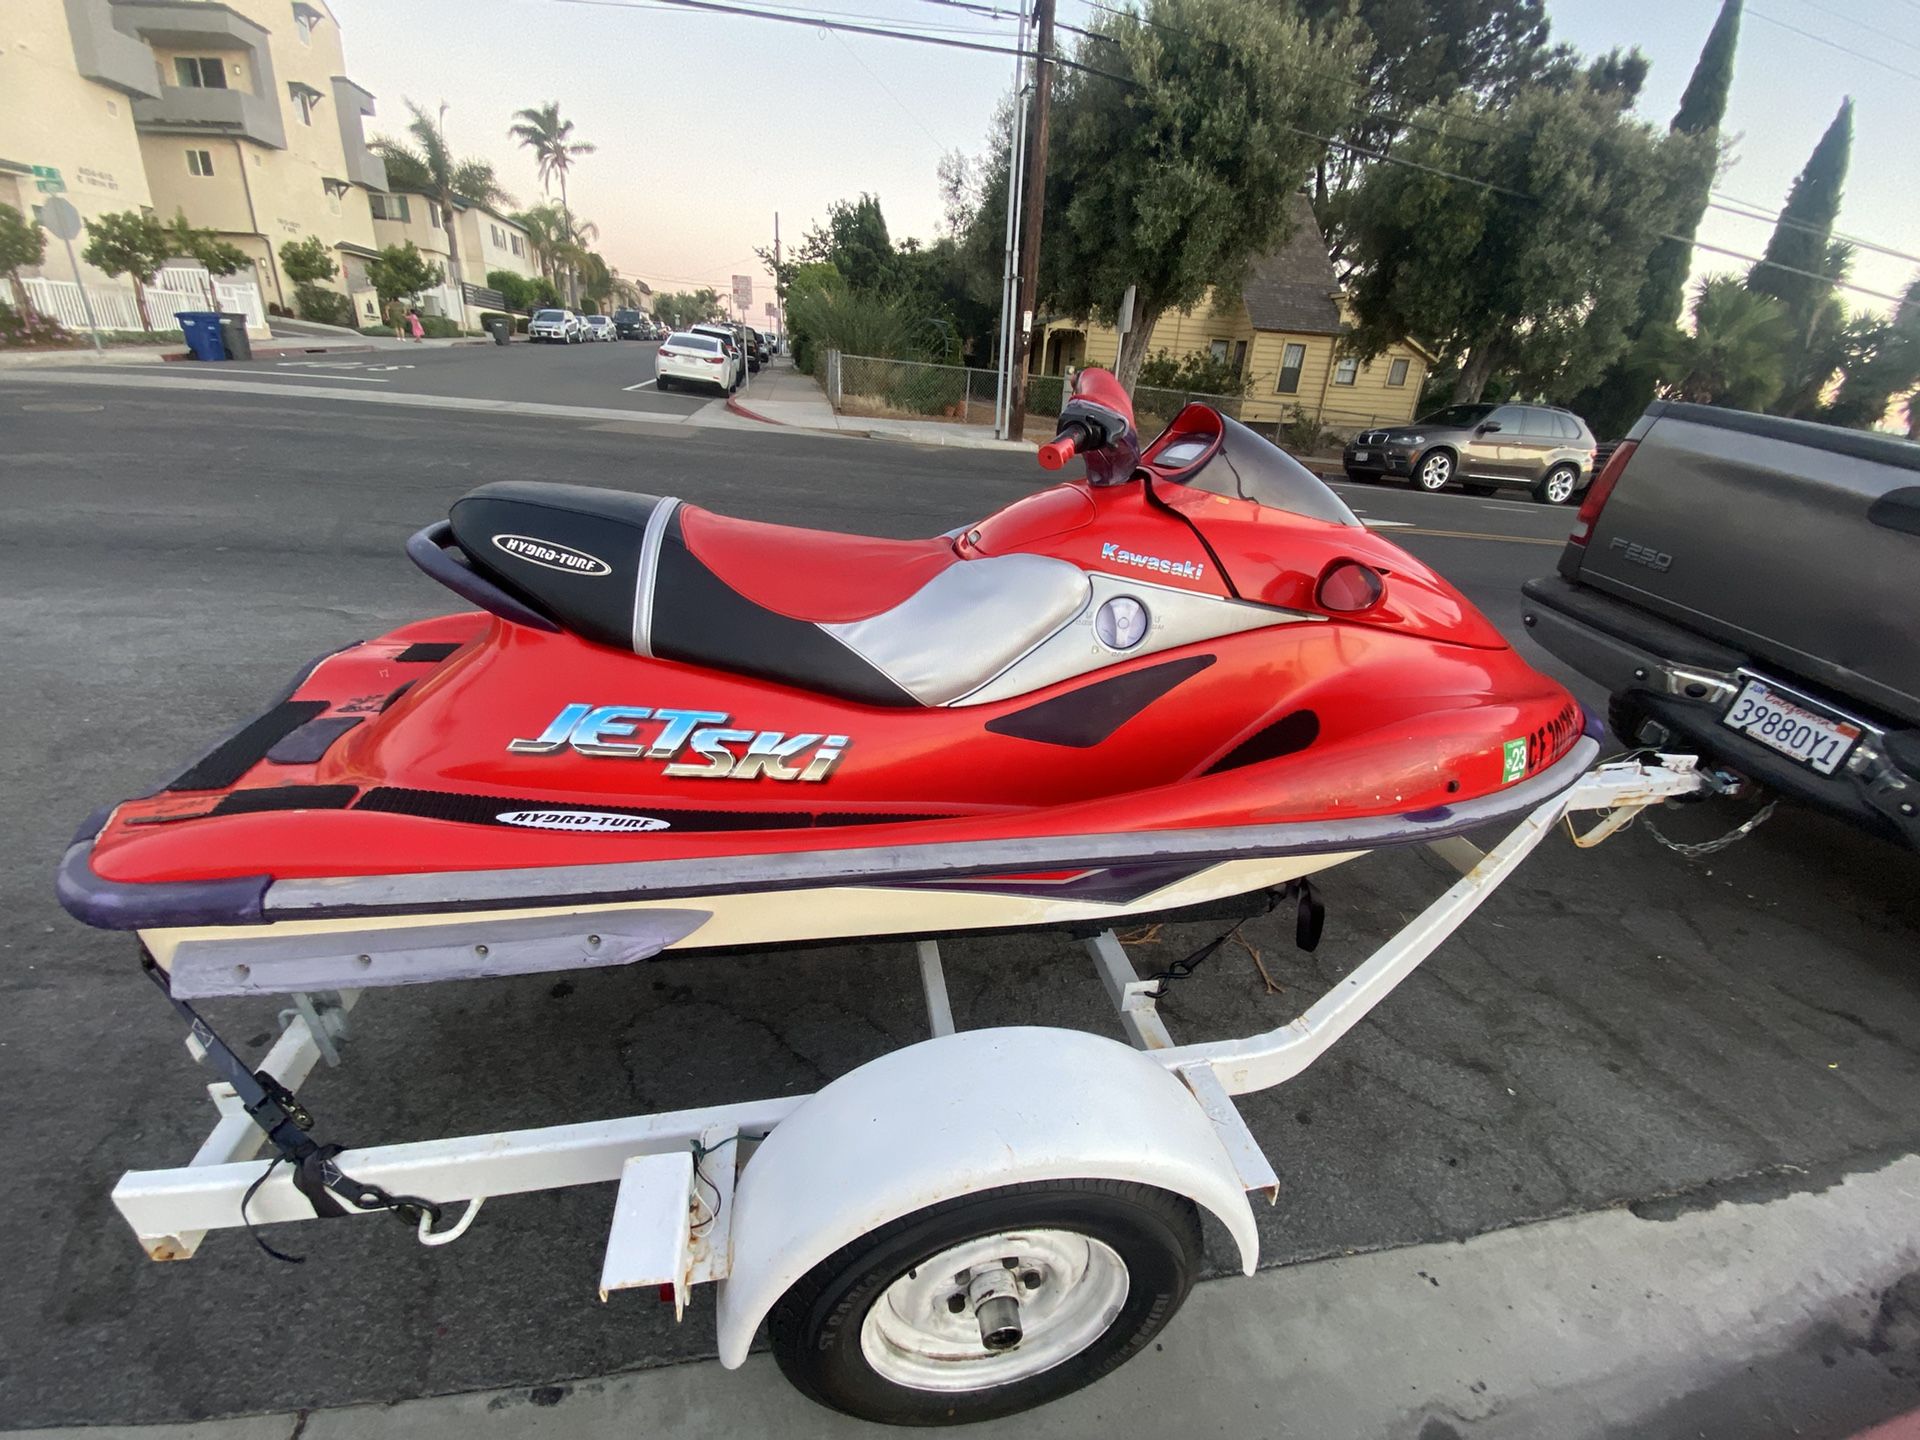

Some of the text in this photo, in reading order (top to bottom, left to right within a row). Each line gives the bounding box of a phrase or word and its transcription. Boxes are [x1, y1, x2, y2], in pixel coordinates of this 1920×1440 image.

[506, 538, 596, 571] HYDRO-TURF
[1101, 542, 1204, 580] Kawasaki
[506, 703, 731, 759] JET
[1528, 727, 1545, 773] CF
[1733, 698, 1840, 765] 39880Y1
[1511, 746, 1526, 772] 23
[512, 813, 655, 829] HYDRO-TURF
